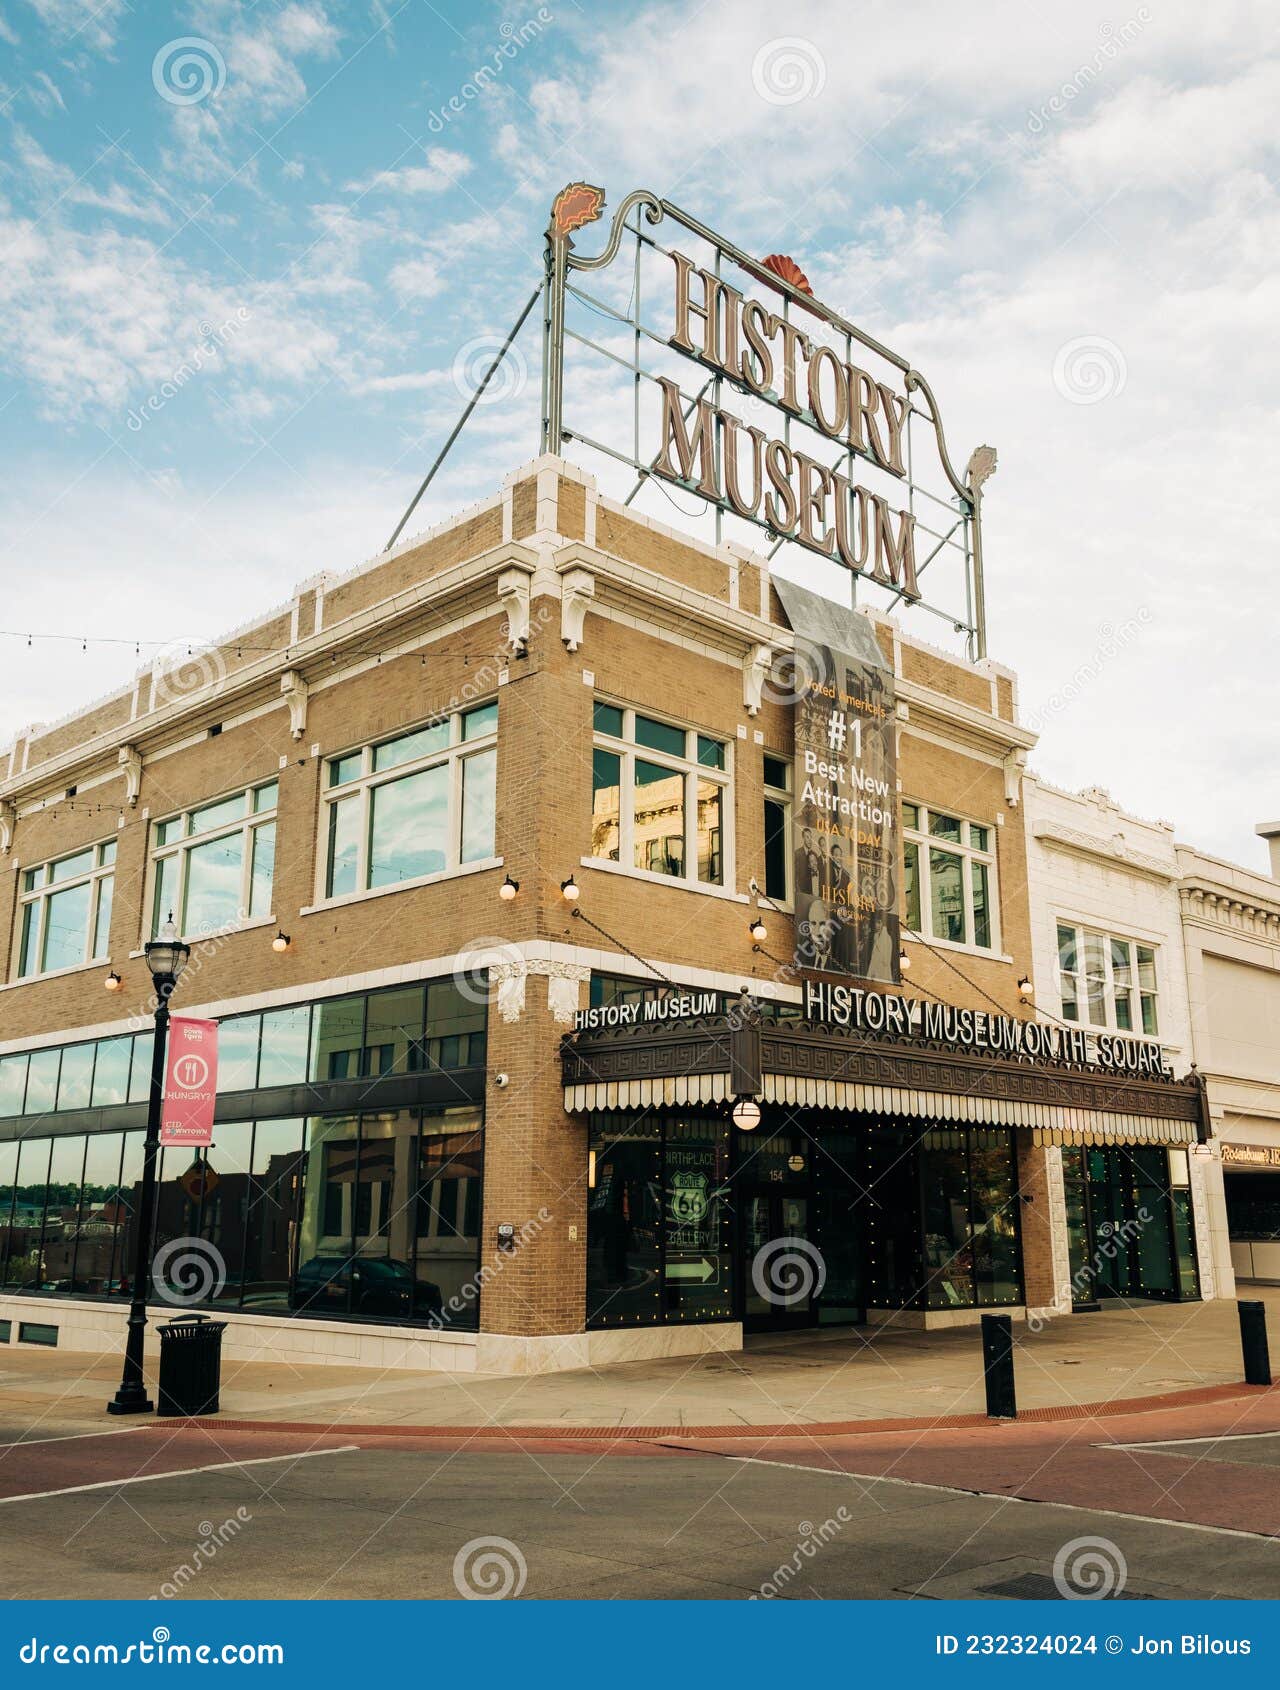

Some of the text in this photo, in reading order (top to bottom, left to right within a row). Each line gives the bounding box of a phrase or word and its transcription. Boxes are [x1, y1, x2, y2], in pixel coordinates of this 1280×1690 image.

[668, 250, 913, 477] HISTORY
[652, 376, 922, 600] MUSEUM
[828, 710, 862, 759] #1
[804, 750, 890, 798] Best New
[800, 780, 893, 828] Attraction
[815, 819, 881, 847] USA TODAY
[575, 993, 717, 1029] HISTORY MUSEUM
[804, 979, 1171, 1075] HISTORY MUSEUM ON THE SQUARE
[168, 1091, 211, 1100] HUNGRY?
[680, 1177, 702, 1187] ROUTE
[769, 1170, 784, 1182] 154
[678, 1192, 702, 1215] 66
